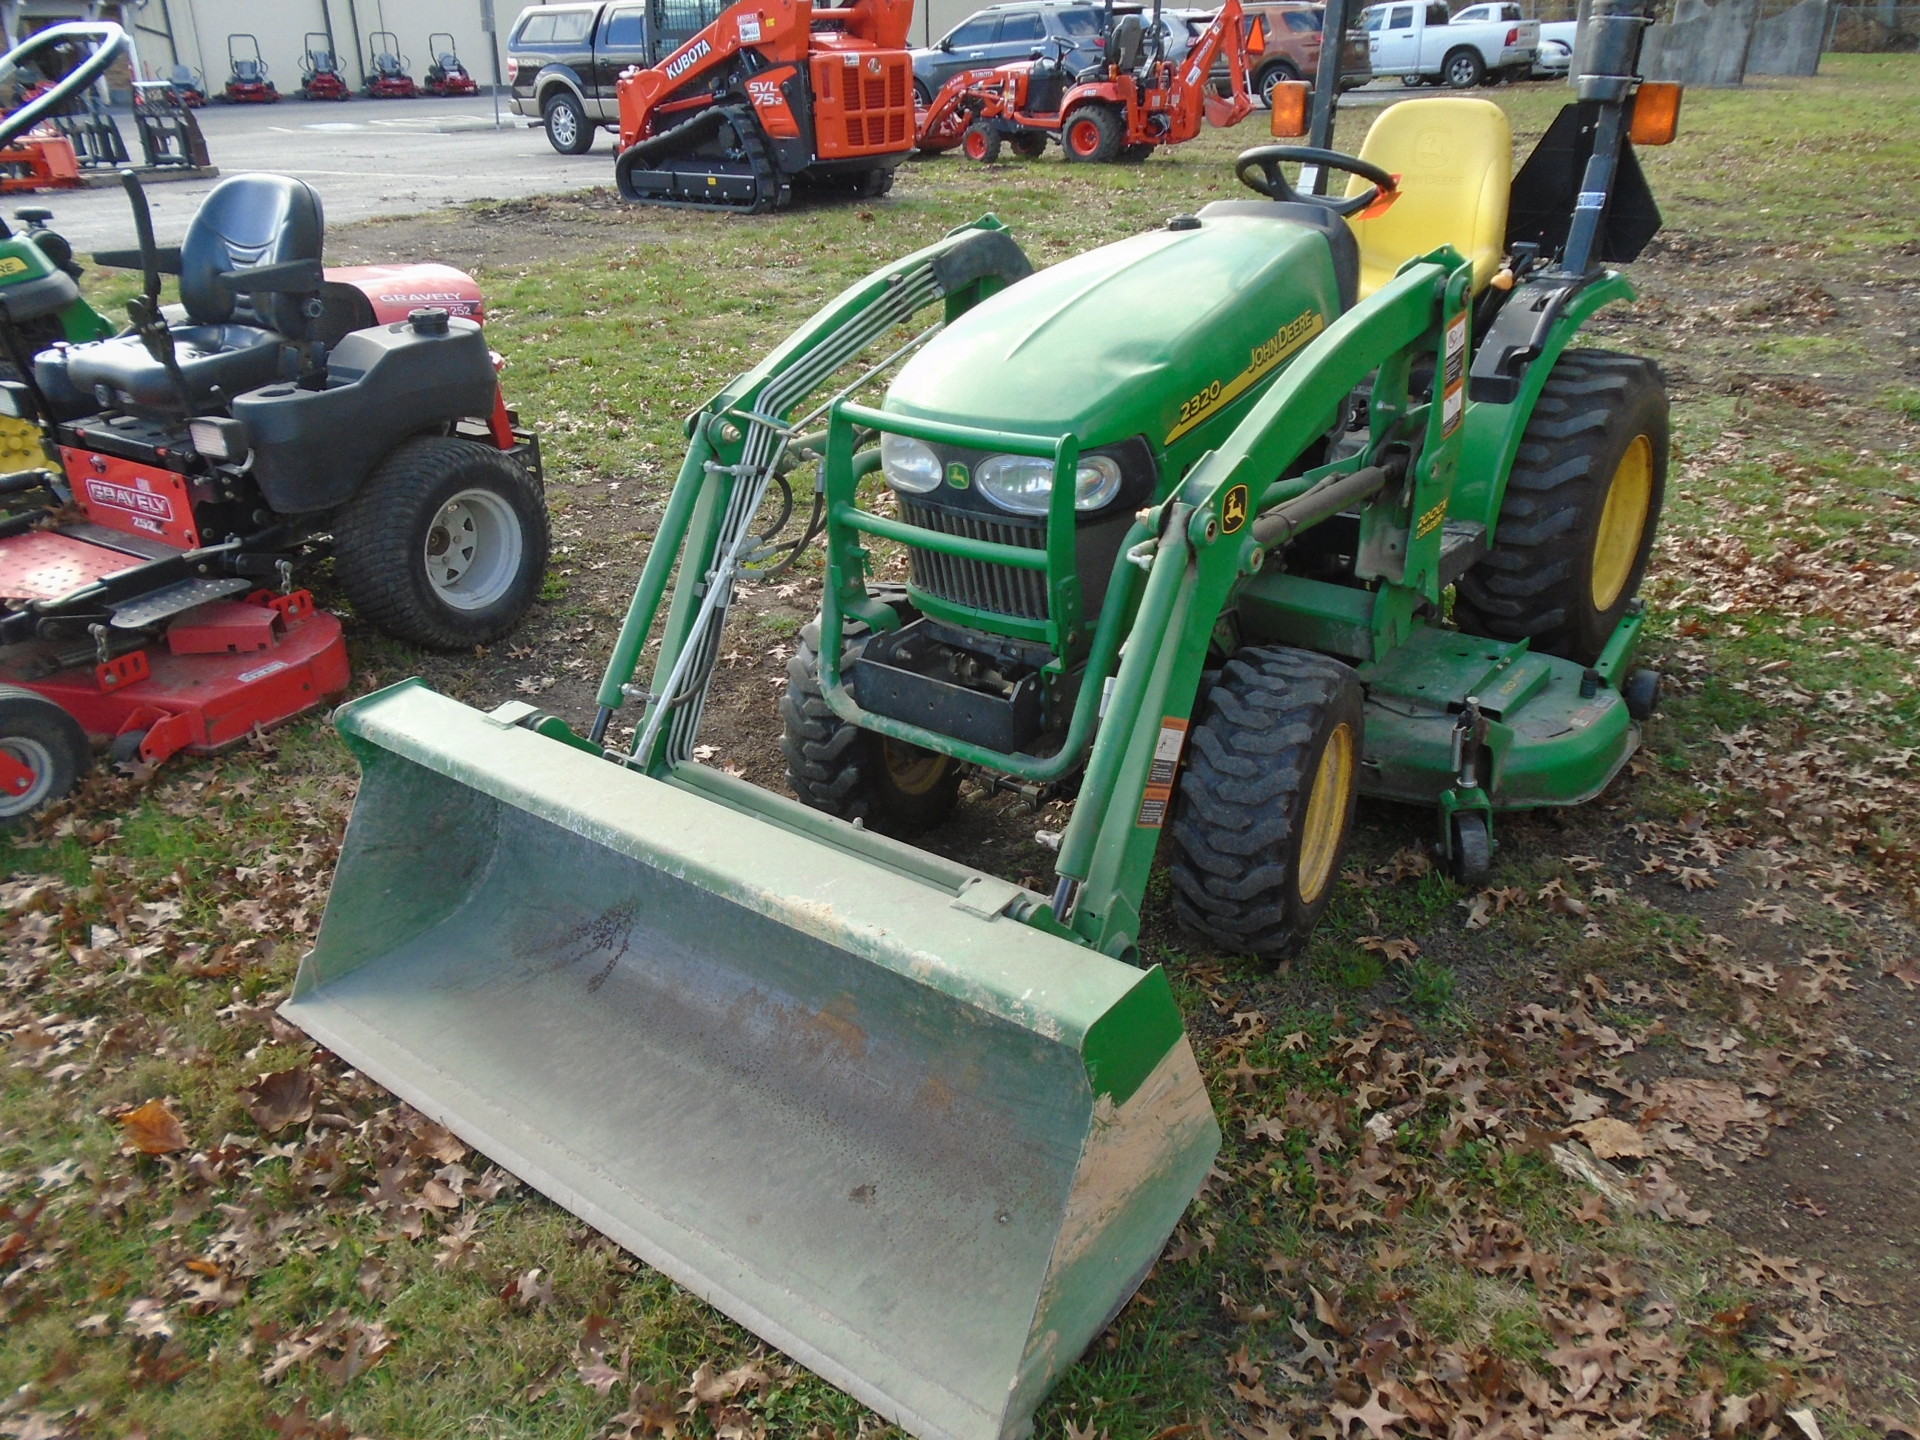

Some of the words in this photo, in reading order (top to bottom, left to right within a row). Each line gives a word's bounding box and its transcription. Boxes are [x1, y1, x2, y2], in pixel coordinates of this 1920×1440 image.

[665, 39, 712, 80] KUBOTA
[748, 82, 779, 93] SVL
[380, 293, 461, 302] GRAVELY
[1248, 335, 1279, 373] JOHN
[1277, 309, 1313, 348] DEERE
[1180, 379, 1221, 424] 2320
[90, 484, 166, 514] GRAVELY
